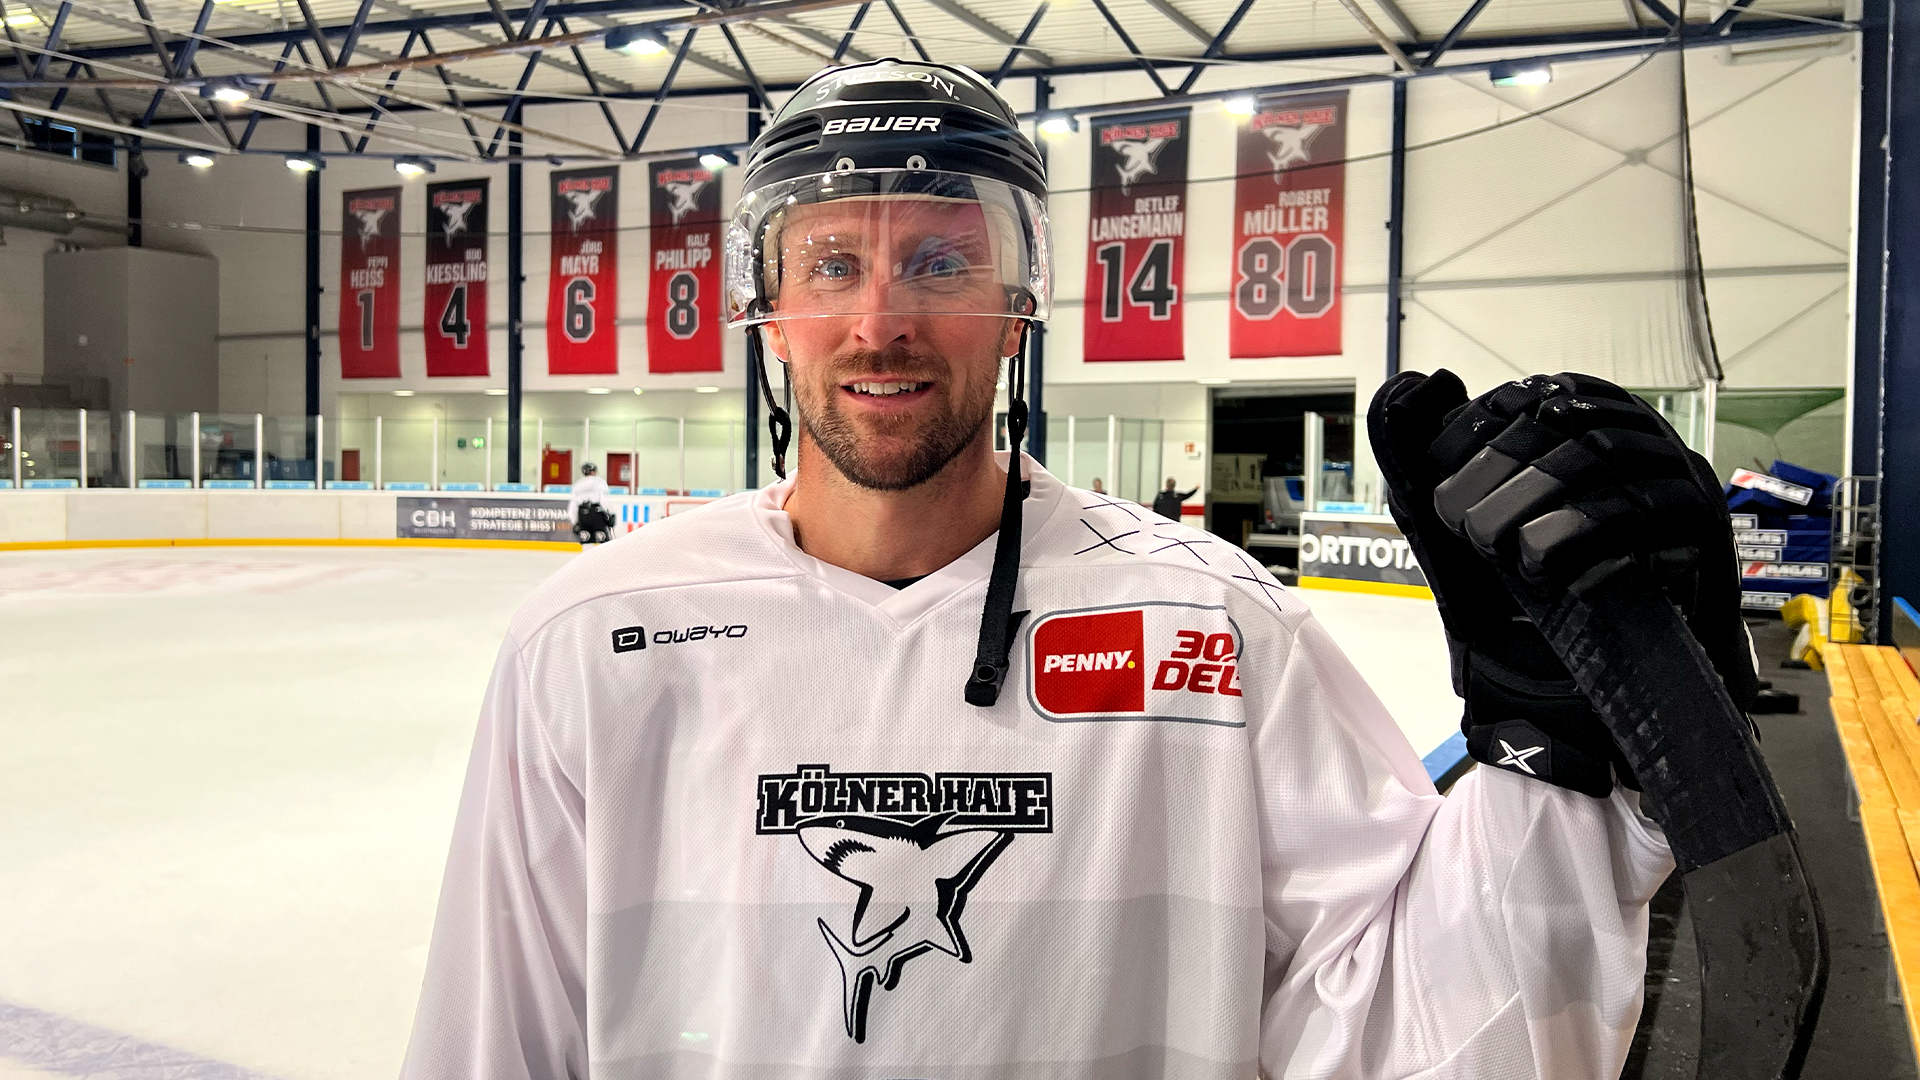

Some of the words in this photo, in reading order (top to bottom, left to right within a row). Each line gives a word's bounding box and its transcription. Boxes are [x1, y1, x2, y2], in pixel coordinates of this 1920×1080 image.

[816, 70, 956, 102] STETSON
[1135, 195, 1180, 214] DETLEF
[1279, 188, 1331, 206] ROBERT
[1091, 212, 1184, 242] LANGEMANN
[1243, 205, 1329, 236] MÜLLER
[687, 233, 711, 247] RALF
[426, 262, 487, 285] KIESSLING
[560, 254, 599, 276] MAYR
[655, 248, 712, 271] PHILIPP
[350, 269, 384, 288] HEISS
[1096, 238, 1179, 323] 14
[1235, 233, 1336, 321] 80
[357, 288, 375, 351] 1
[440, 282, 471, 349] 4
[564, 276, 596, 343] 6
[666, 270, 699, 340] 8
[470, 507, 531, 519] KOMPETENZ
[470, 519, 523, 531] STRATEGIE
[530, 520, 550, 532] BISS
[1170, 629, 1235, 662] 30
[761, 769, 930, 830] KÖLNER
[940, 777, 1048, 828] HAIE
